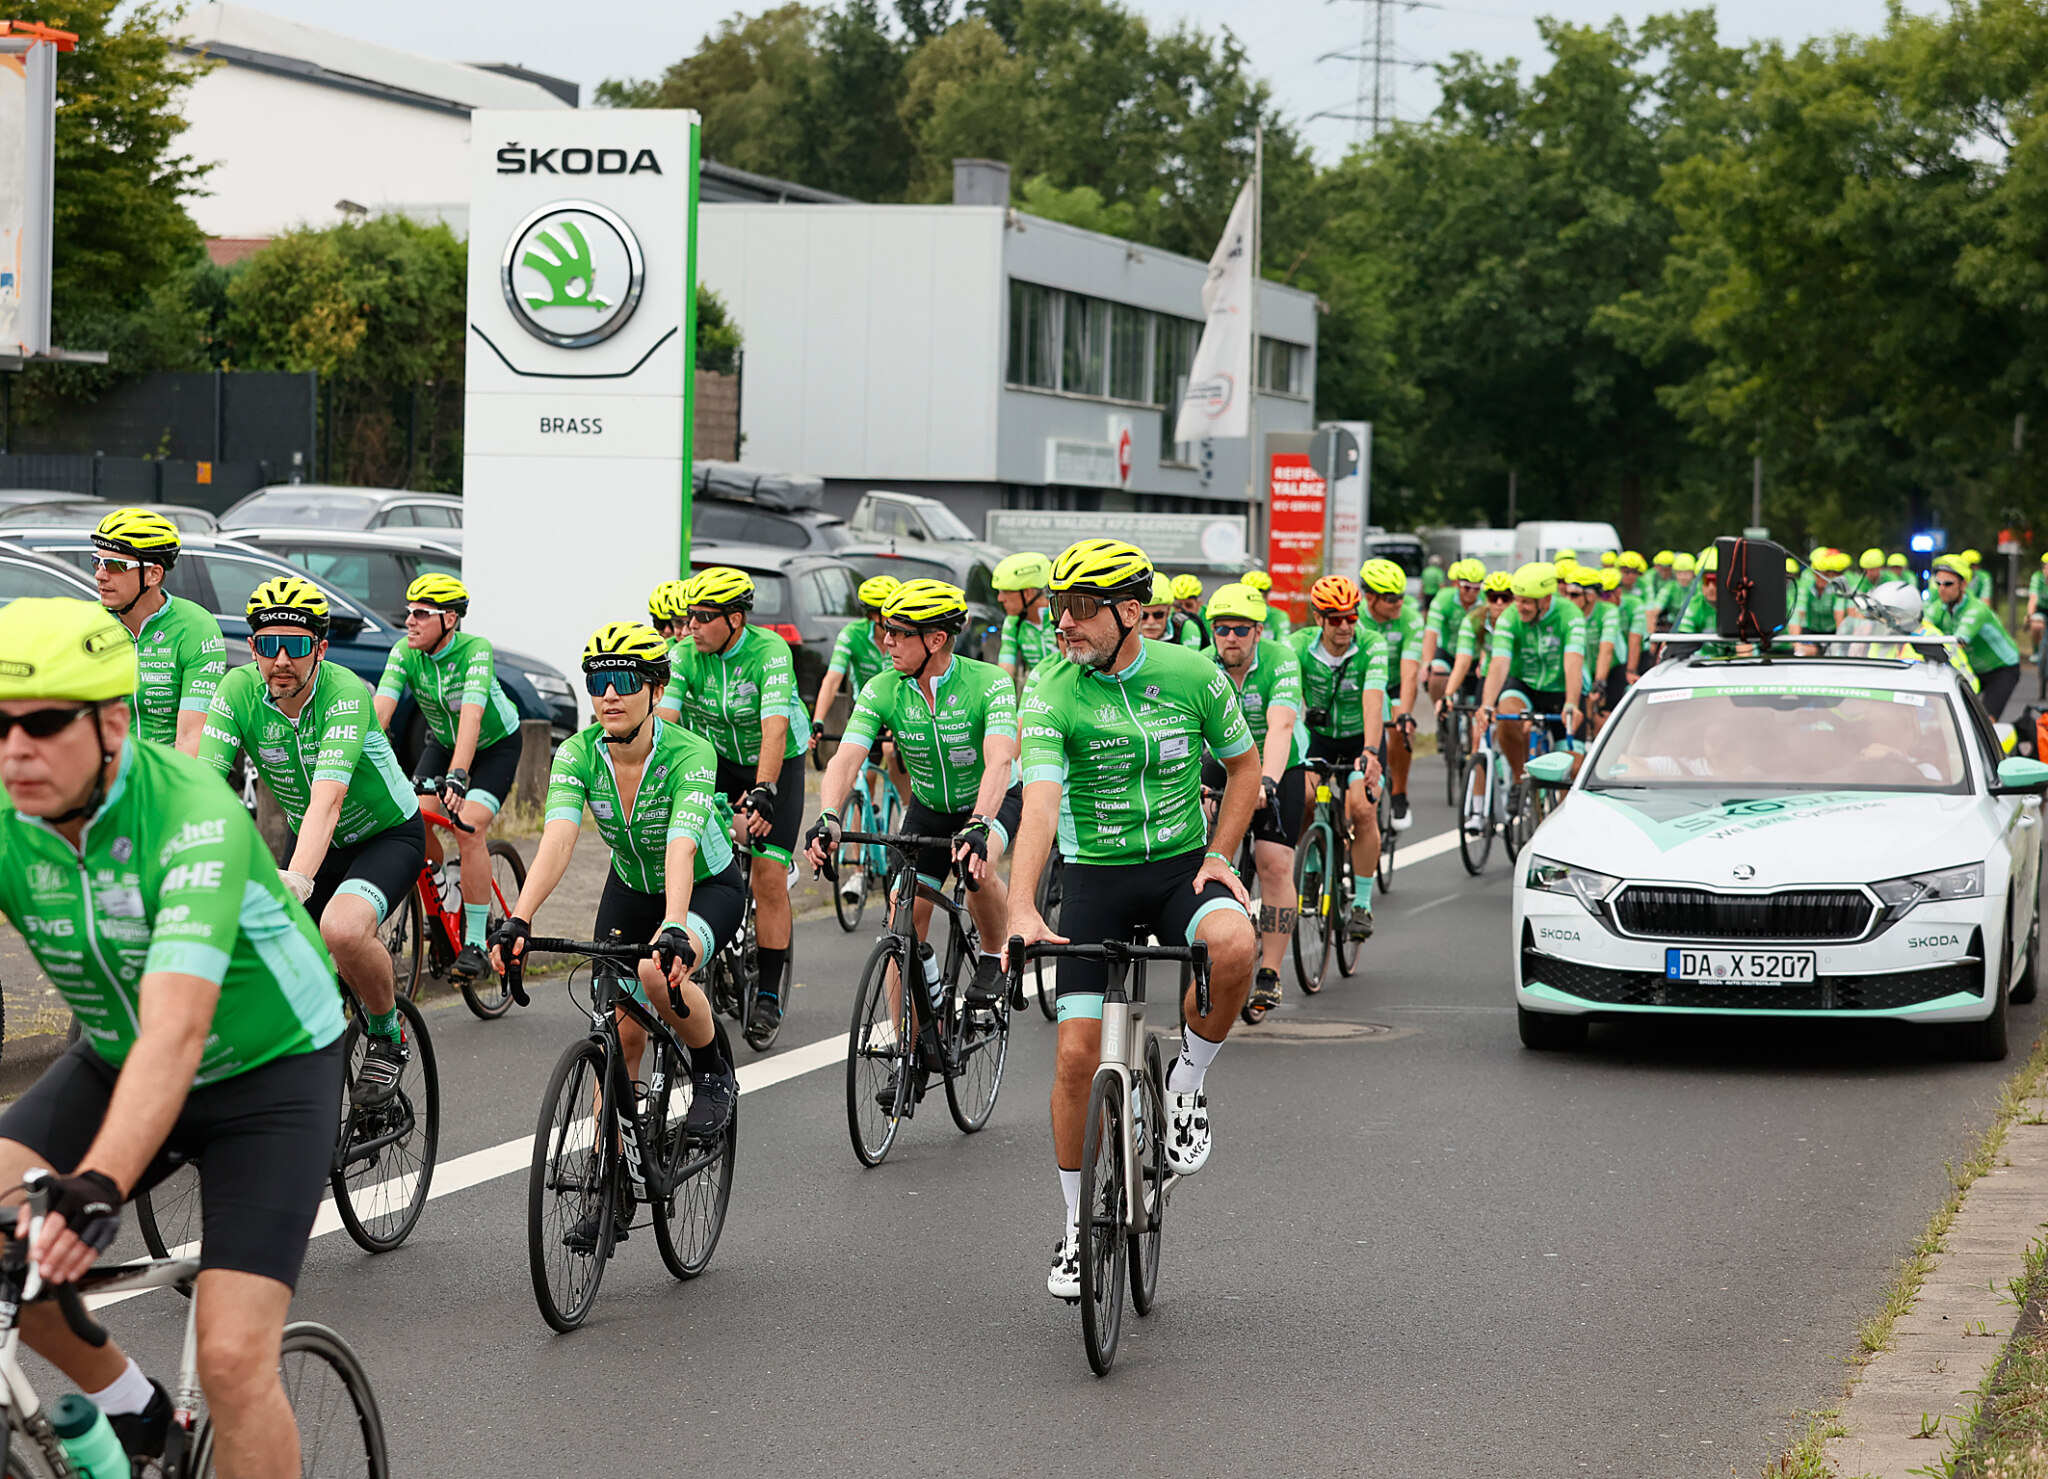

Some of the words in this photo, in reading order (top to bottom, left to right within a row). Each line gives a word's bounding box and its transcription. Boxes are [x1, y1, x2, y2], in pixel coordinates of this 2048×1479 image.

[497, 142, 663, 175] ŠKODA
[540, 417, 602, 434] BRASS
[997, 517, 1050, 529] REIFEN
[199, 661, 226, 674] AHE
[192, 680, 217, 690] one
[764, 673, 789, 687] AHE
[1275, 676, 1299, 689] AHE
[1716, 687, 1755, 695] TOUR
[1791, 686, 1872, 697] HOFFNUNG
[988, 694, 1016, 708] AHE
[987, 711, 1012, 721] one
[322, 725, 358, 740] AHE
[898, 730, 925, 741] SWG
[1089, 736, 1130, 750] SWG
[676, 810, 705, 826] one
[1707, 826, 1745, 841] We
[1540, 928, 1581, 942] SKODA
[1908, 934, 1960, 948] SKODA
[1682, 954, 1712, 976] DA
[1730, 955, 1744, 977] X
[1751, 955, 1811, 978] 5207
[616, 1107, 646, 1184] FELT
